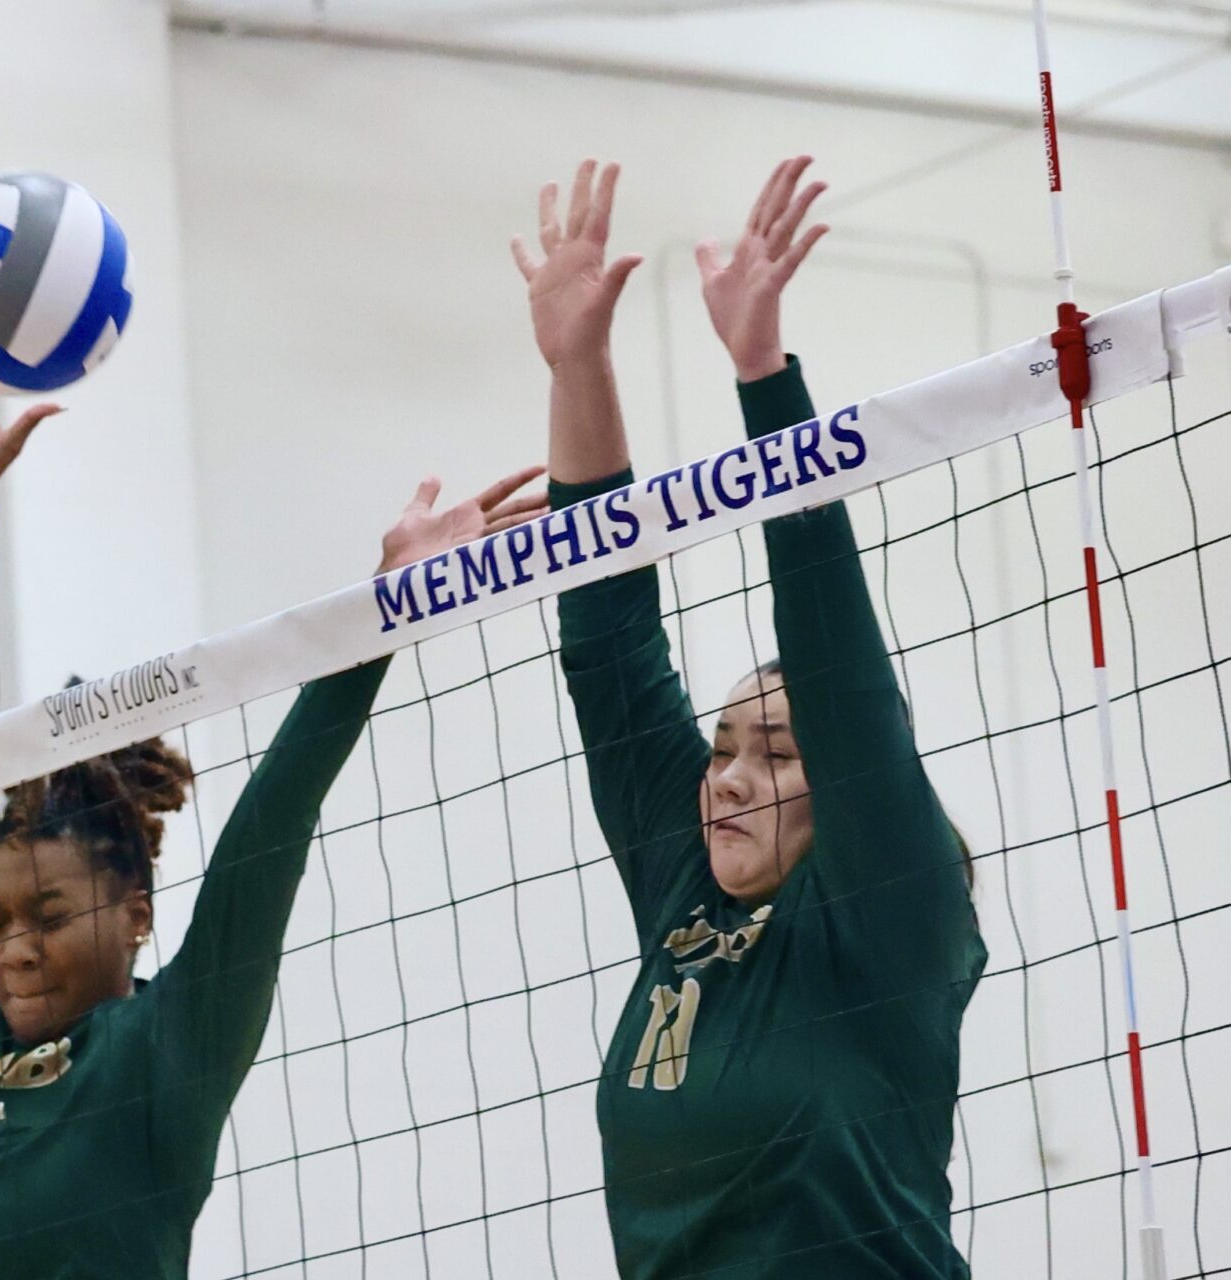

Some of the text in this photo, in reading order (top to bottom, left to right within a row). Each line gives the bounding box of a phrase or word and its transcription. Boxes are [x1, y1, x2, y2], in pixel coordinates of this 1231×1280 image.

[373, 404, 867, 632] MEMPHIS TIGERS
[43, 677, 109, 737] SPORTS
[110, 652, 179, 714] FLOORS
